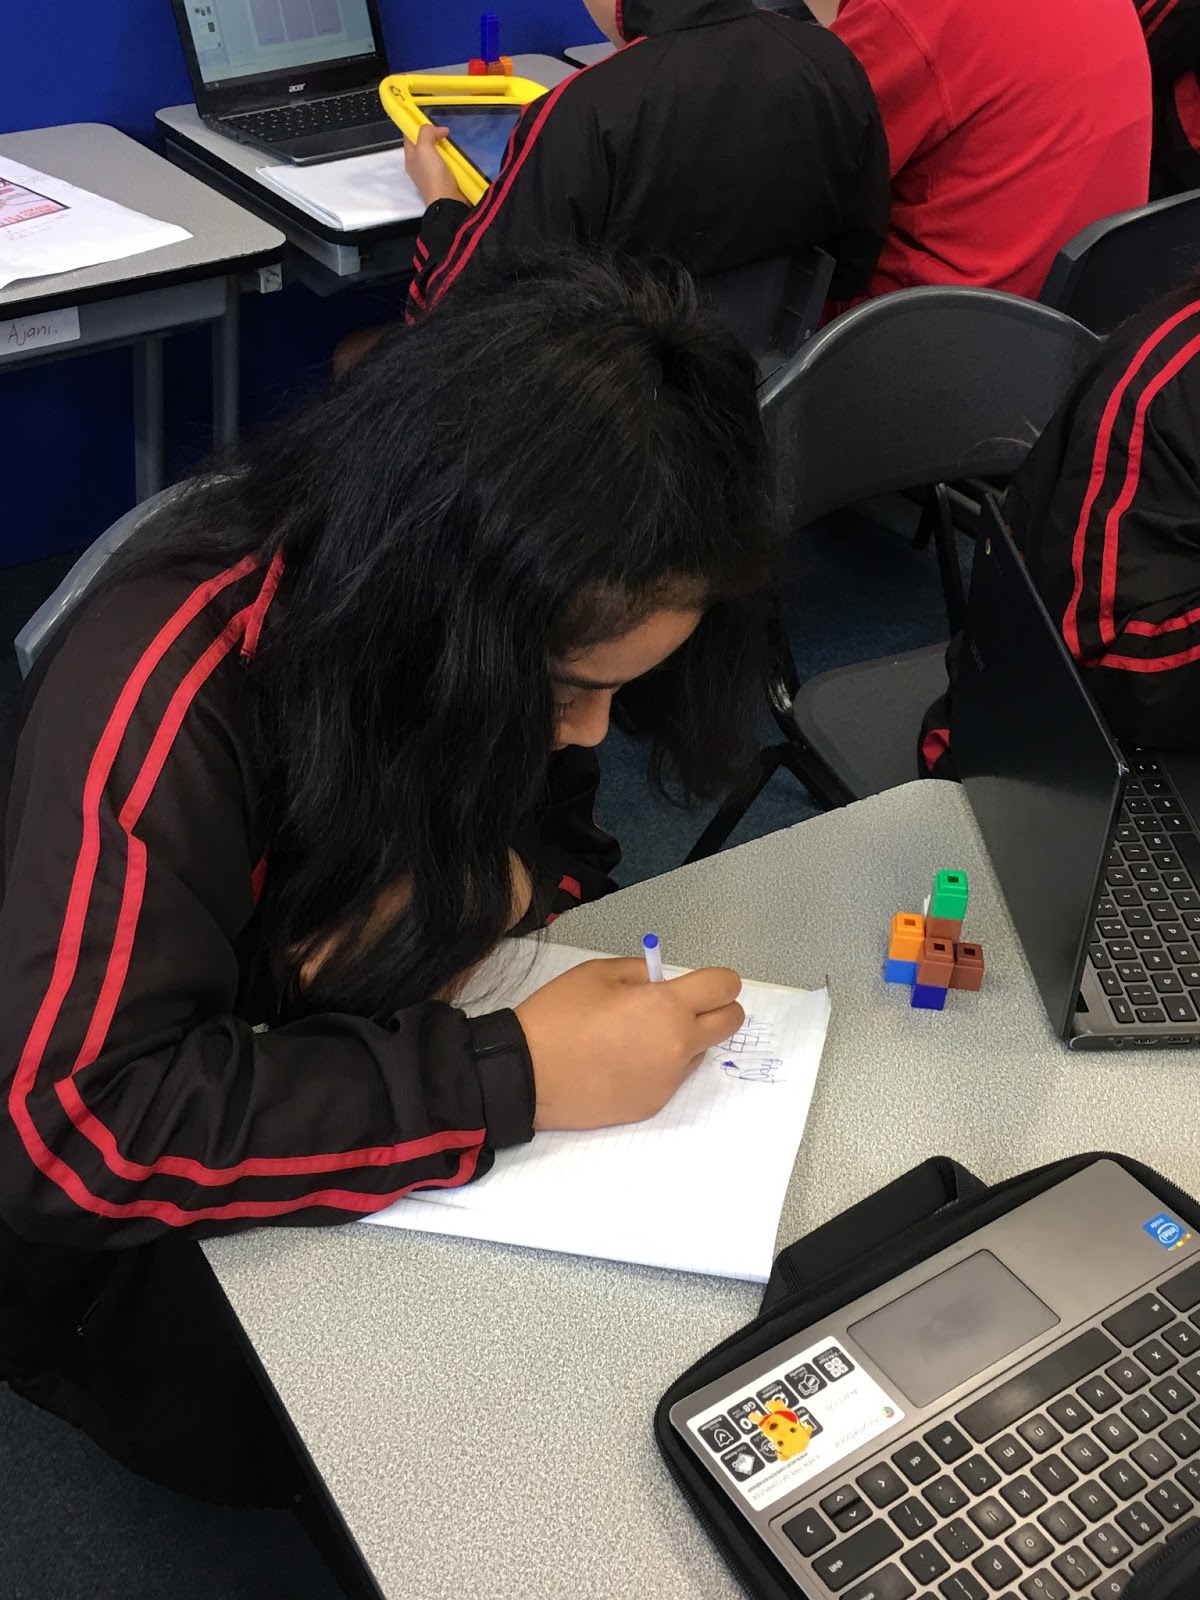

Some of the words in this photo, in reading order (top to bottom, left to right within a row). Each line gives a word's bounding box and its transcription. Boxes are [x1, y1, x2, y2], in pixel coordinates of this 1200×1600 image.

[288, 83, 306, 93] acer
[1160, 1225, 1178, 1241] intel
[1178, 1332, 1188, 1342] z
[1151, 1351, 1162, 1360] x
[1123, 1369, 1133, 1379] c
[1095, 1388, 1105, 1398] v
[1167, 1388, 1178, 1400] d
[742, 1400, 757, 1414] GB
[1065, 1407, 1077, 1417] b
[1141, 1407, 1151, 1419] f
[700, 1415, 723, 1433] Protection
[1035, 1427, 1045, 1437] n
[1108, 1425, 1120, 1437] g
[1179, 1432, 1187, 1441] r
[1002, 1446, 1015, 1458] m
[1079, 1447, 1093, 1457] h
[909, 1455, 921, 1467] ctrl
[1149, 1453, 1159, 1463] t
[746, 1451, 809, 1494] www.acer.com/chromebook
[1048, 1466, 1060, 1479] j
[1118, 1471, 1129, 1483] y
[1188, 1467, 1199, 1478] 5
[752, 1478, 784, 1501] COMPUTER
[1018, 1488, 1031, 1499] k
[1159, 1488, 1169, 1499] 6
[1088, 1494, 1098, 1505] u
[1129, 1509, 1139, 1521] 7
[1058, 1517, 1068, 1528] i
[1097, 1531, 1107, 1542] 8
[1025, 1538, 1035, 1549] o
[993, 1558, 1003, 1571] p
[1066, 1554, 1076, 1565] 9
[827, 1559, 844, 1574] shift
[1033, 1577, 1044, 1588] 0
